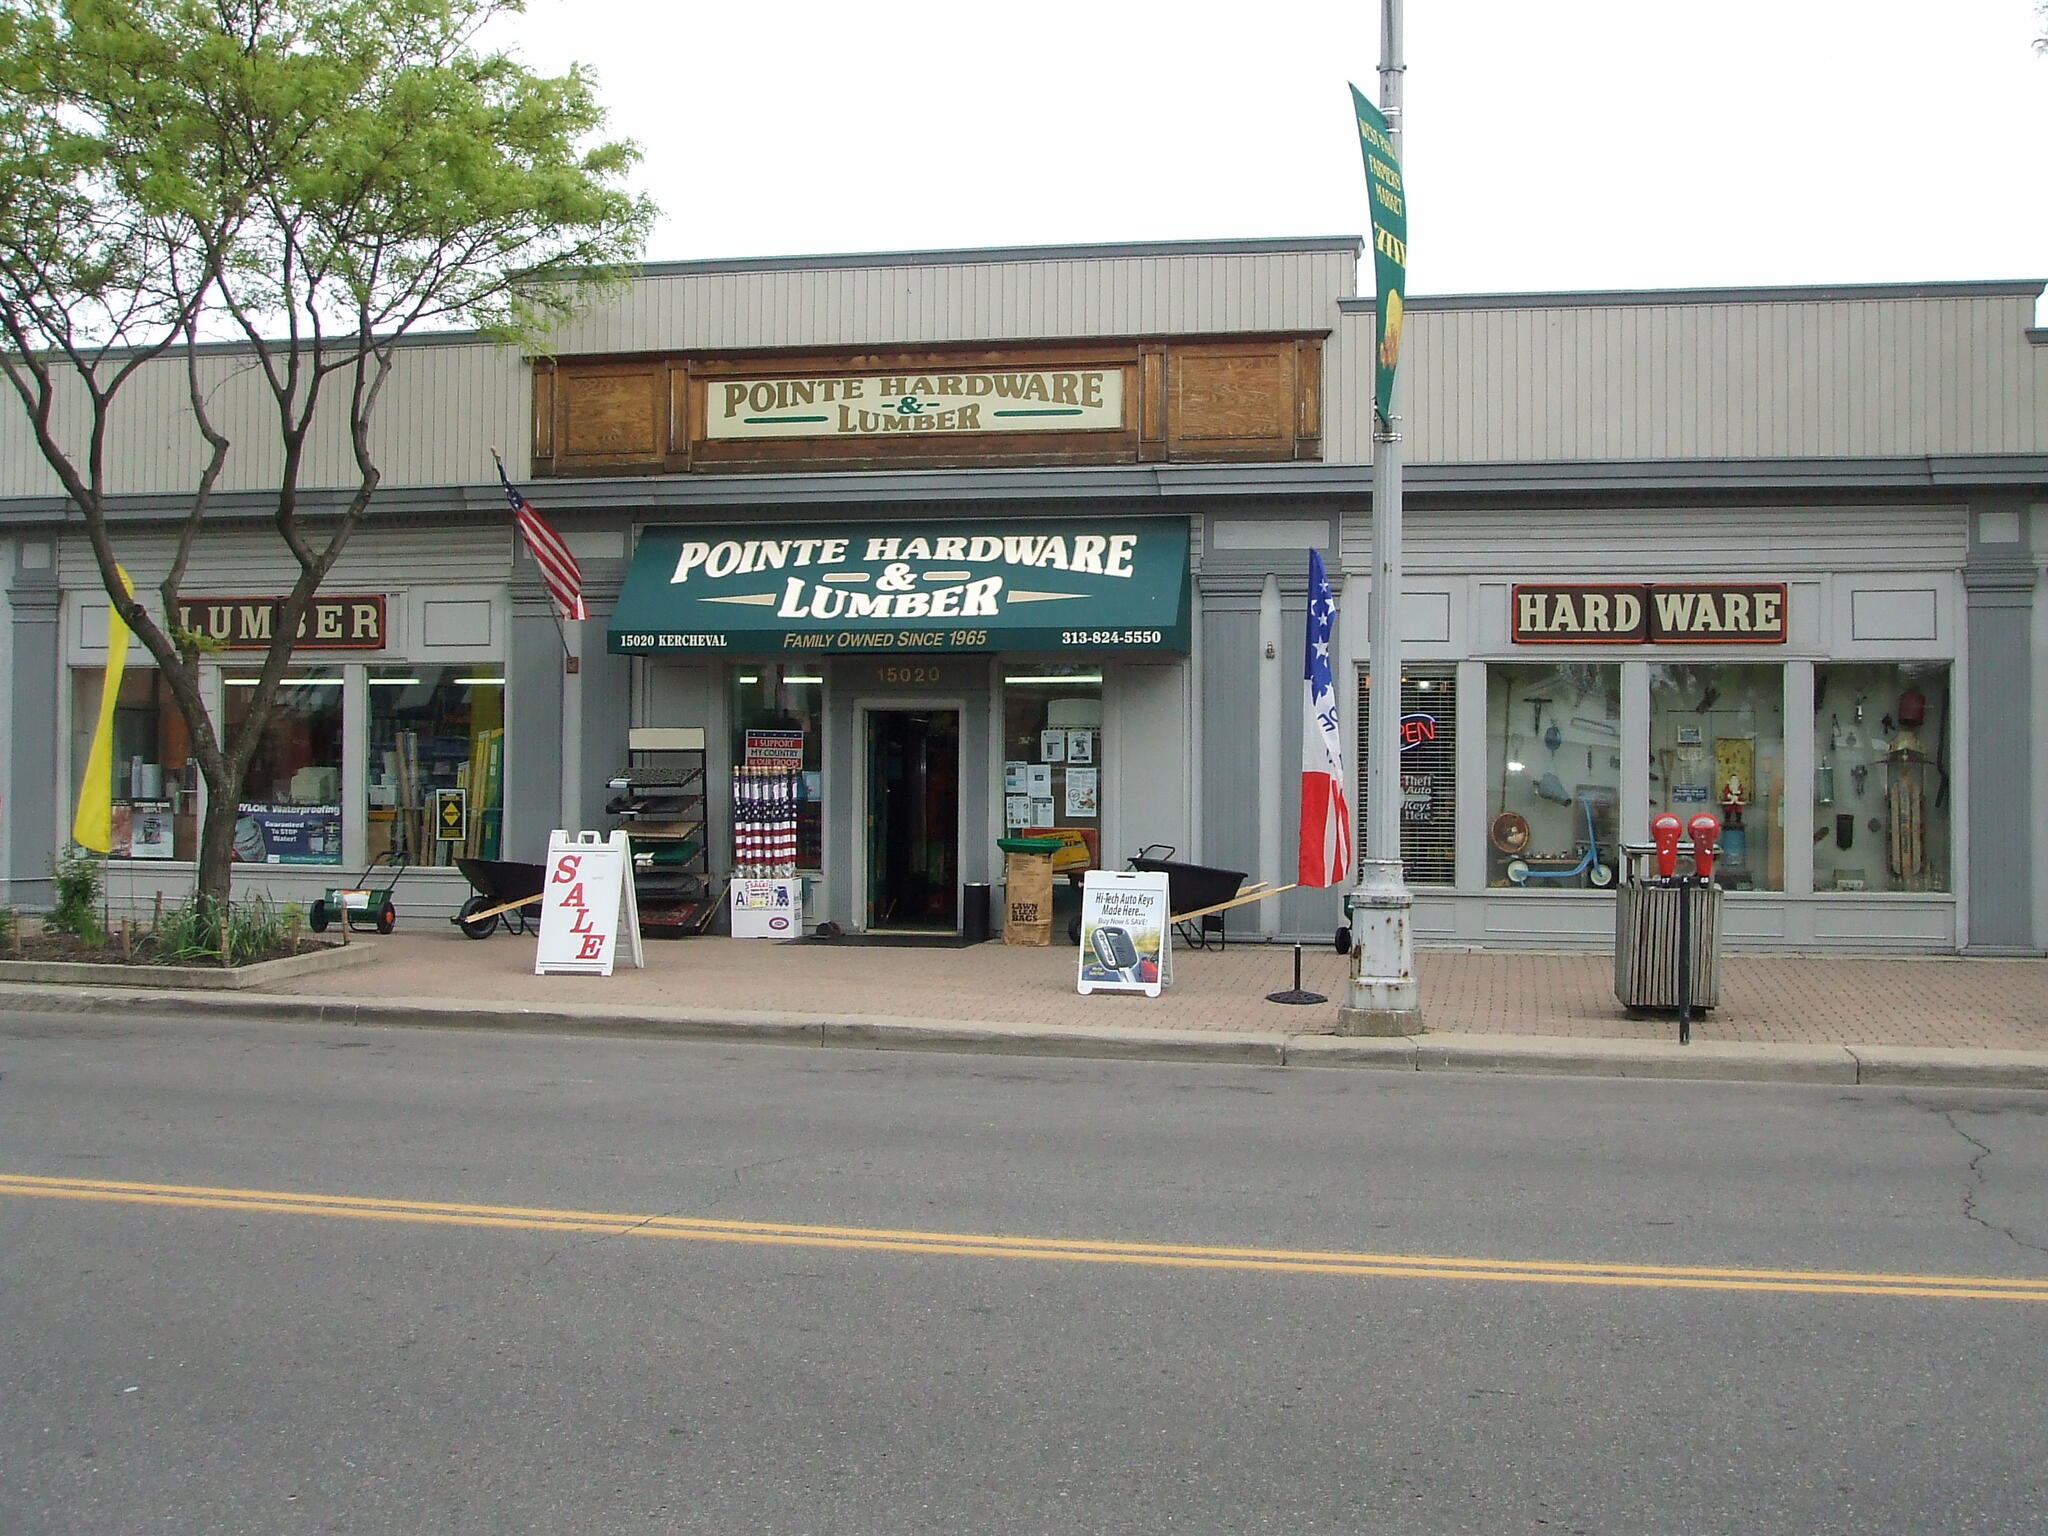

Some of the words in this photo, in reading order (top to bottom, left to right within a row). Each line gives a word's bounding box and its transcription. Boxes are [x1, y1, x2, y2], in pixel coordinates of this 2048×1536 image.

[724, 378, 864, 418] POINTE
[879, 372, 1104, 409] HARDWARE
[896, 396, 924, 415] &
[837, 403, 981, 433] LUMBER
[669, 537, 851, 584] POINTE
[862, 534, 1139, 578] HARDWARE
[875, 562, 917, 592] &
[776, 575, 1004, 618] LUMBER
[620, 634, 655, 647] 15020
[658, 634, 728, 647] KERCHEVAL
[783, 632, 835, 649] FAMILY
[837, 631, 894, 648] OWNED
[897, 630, 945, 647] SINCE
[949, 630, 988, 646] 1965
[1061, 631, 1162, 645] 313-824-5550
[877, 666, 940, 683] 15020
[1400, 719, 1435, 742] EN
[760, 740, 794, 748] SUPPORT
[763, 749, 799, 757] COUNTRY
[1405, 786, 1432, 794] Auto
[239, 803, 268, 813] YLOK
[272, 805, 341, 816] Waterproofing
[1404, 801, 1432, 812] Keys
[1405, 811, 1432, 820] Here
[551, 854, 606, 960] SALE
[1095, 892, 1119, 905] Hi-Tech
[1119, 893, 1137, 905] Auto
[1137, 894, 1154, 908] Keys
[1012, 914, 1039, 922] BAGS
[1101, 904, 1121, 916] Made
